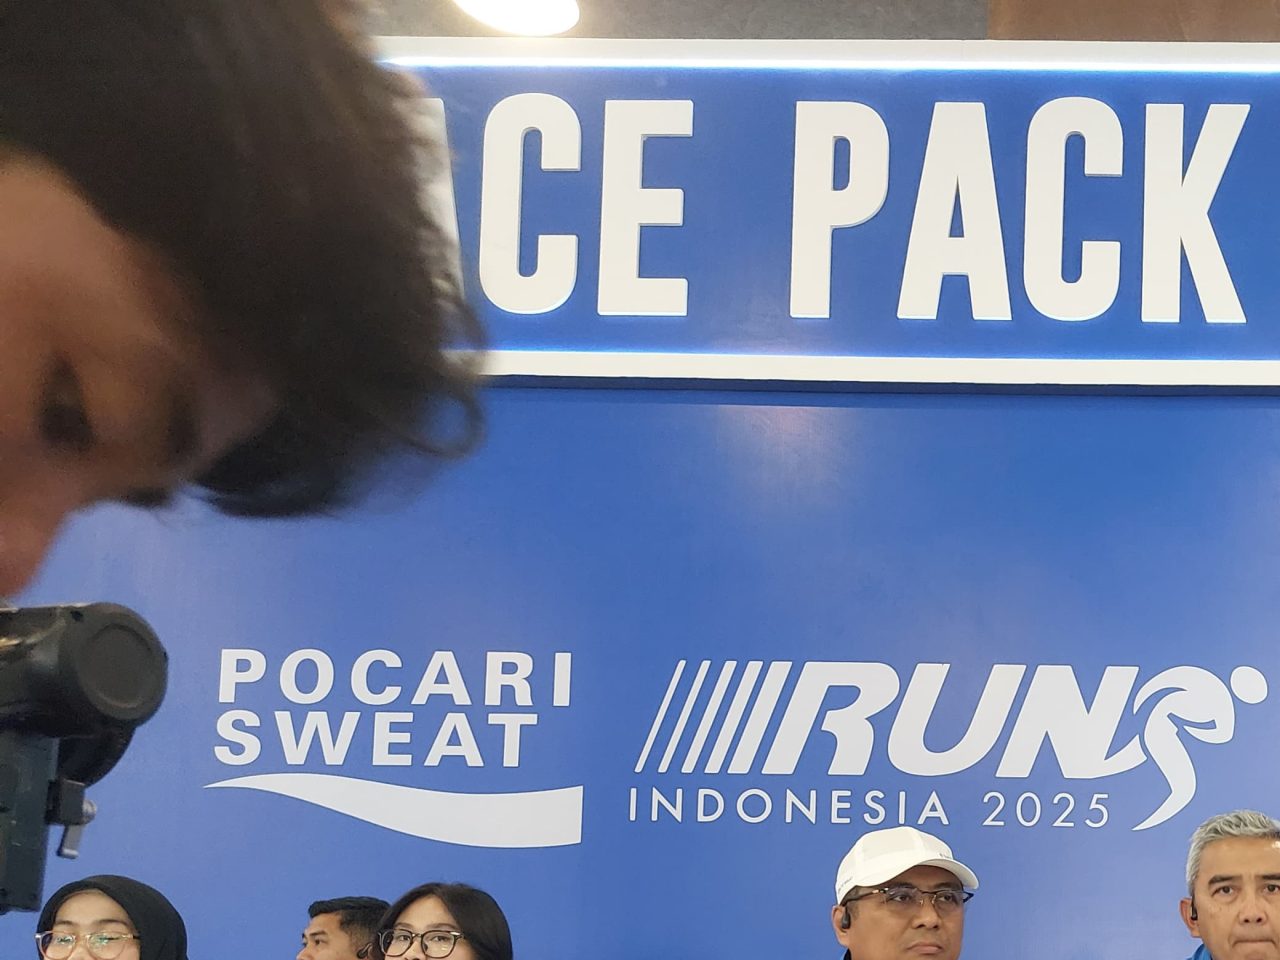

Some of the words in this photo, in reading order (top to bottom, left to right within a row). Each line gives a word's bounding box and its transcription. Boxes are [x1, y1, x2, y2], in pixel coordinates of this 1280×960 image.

[412, 93, 694, 317] CE
[789, 96, 1251, 324] PACK
[218, 648, 572, 707] POCARI
[213, 709, 538, 767] SWEAT
[628, 787, 949, 826] INDONESIA
[982, 791, 1110, 829] 2025
